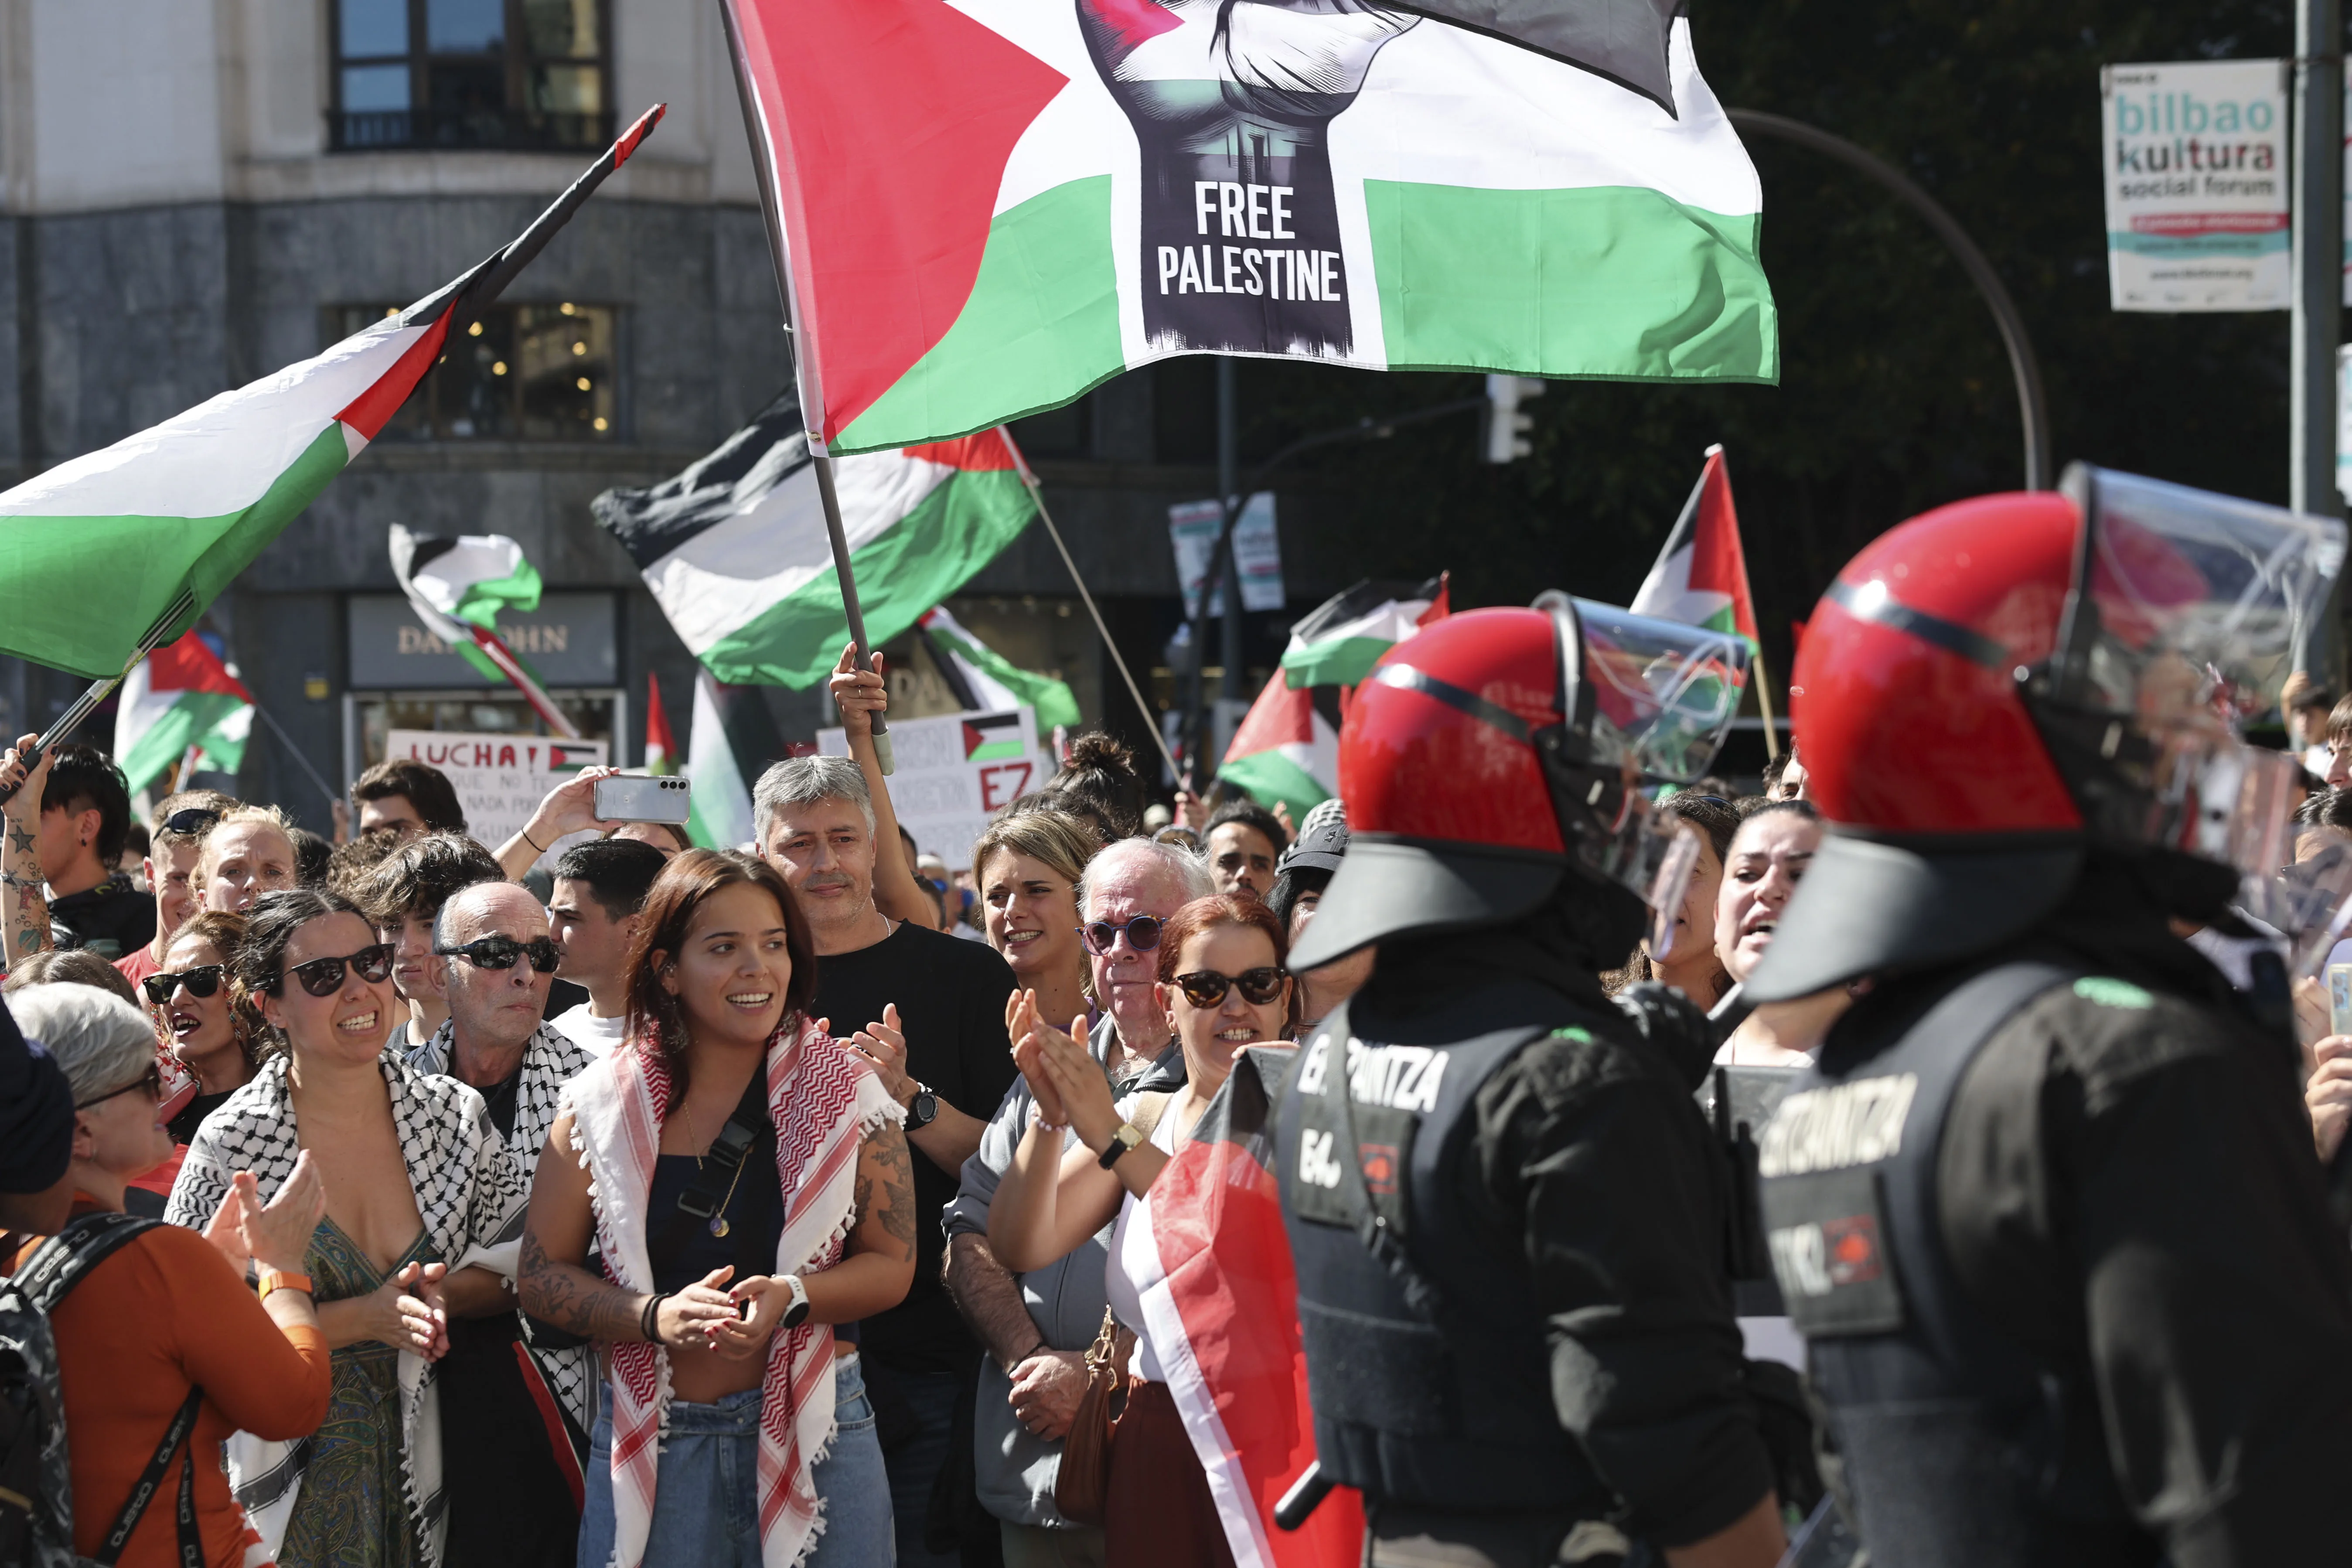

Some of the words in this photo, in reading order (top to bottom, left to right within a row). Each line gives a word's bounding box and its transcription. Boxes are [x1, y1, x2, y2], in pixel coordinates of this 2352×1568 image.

[2116, 93, 2274, 135] bilbao
[2117, 137, 2274, 174] kultura
[1195, 181, 1296, 240] FREE
[2120, 176, 2195, 201] social
[2204, 174, 2276, 198] forum
[1158, 245, 1341, 302] PALESTINE
[978, 759, 1034, 814] EZ
